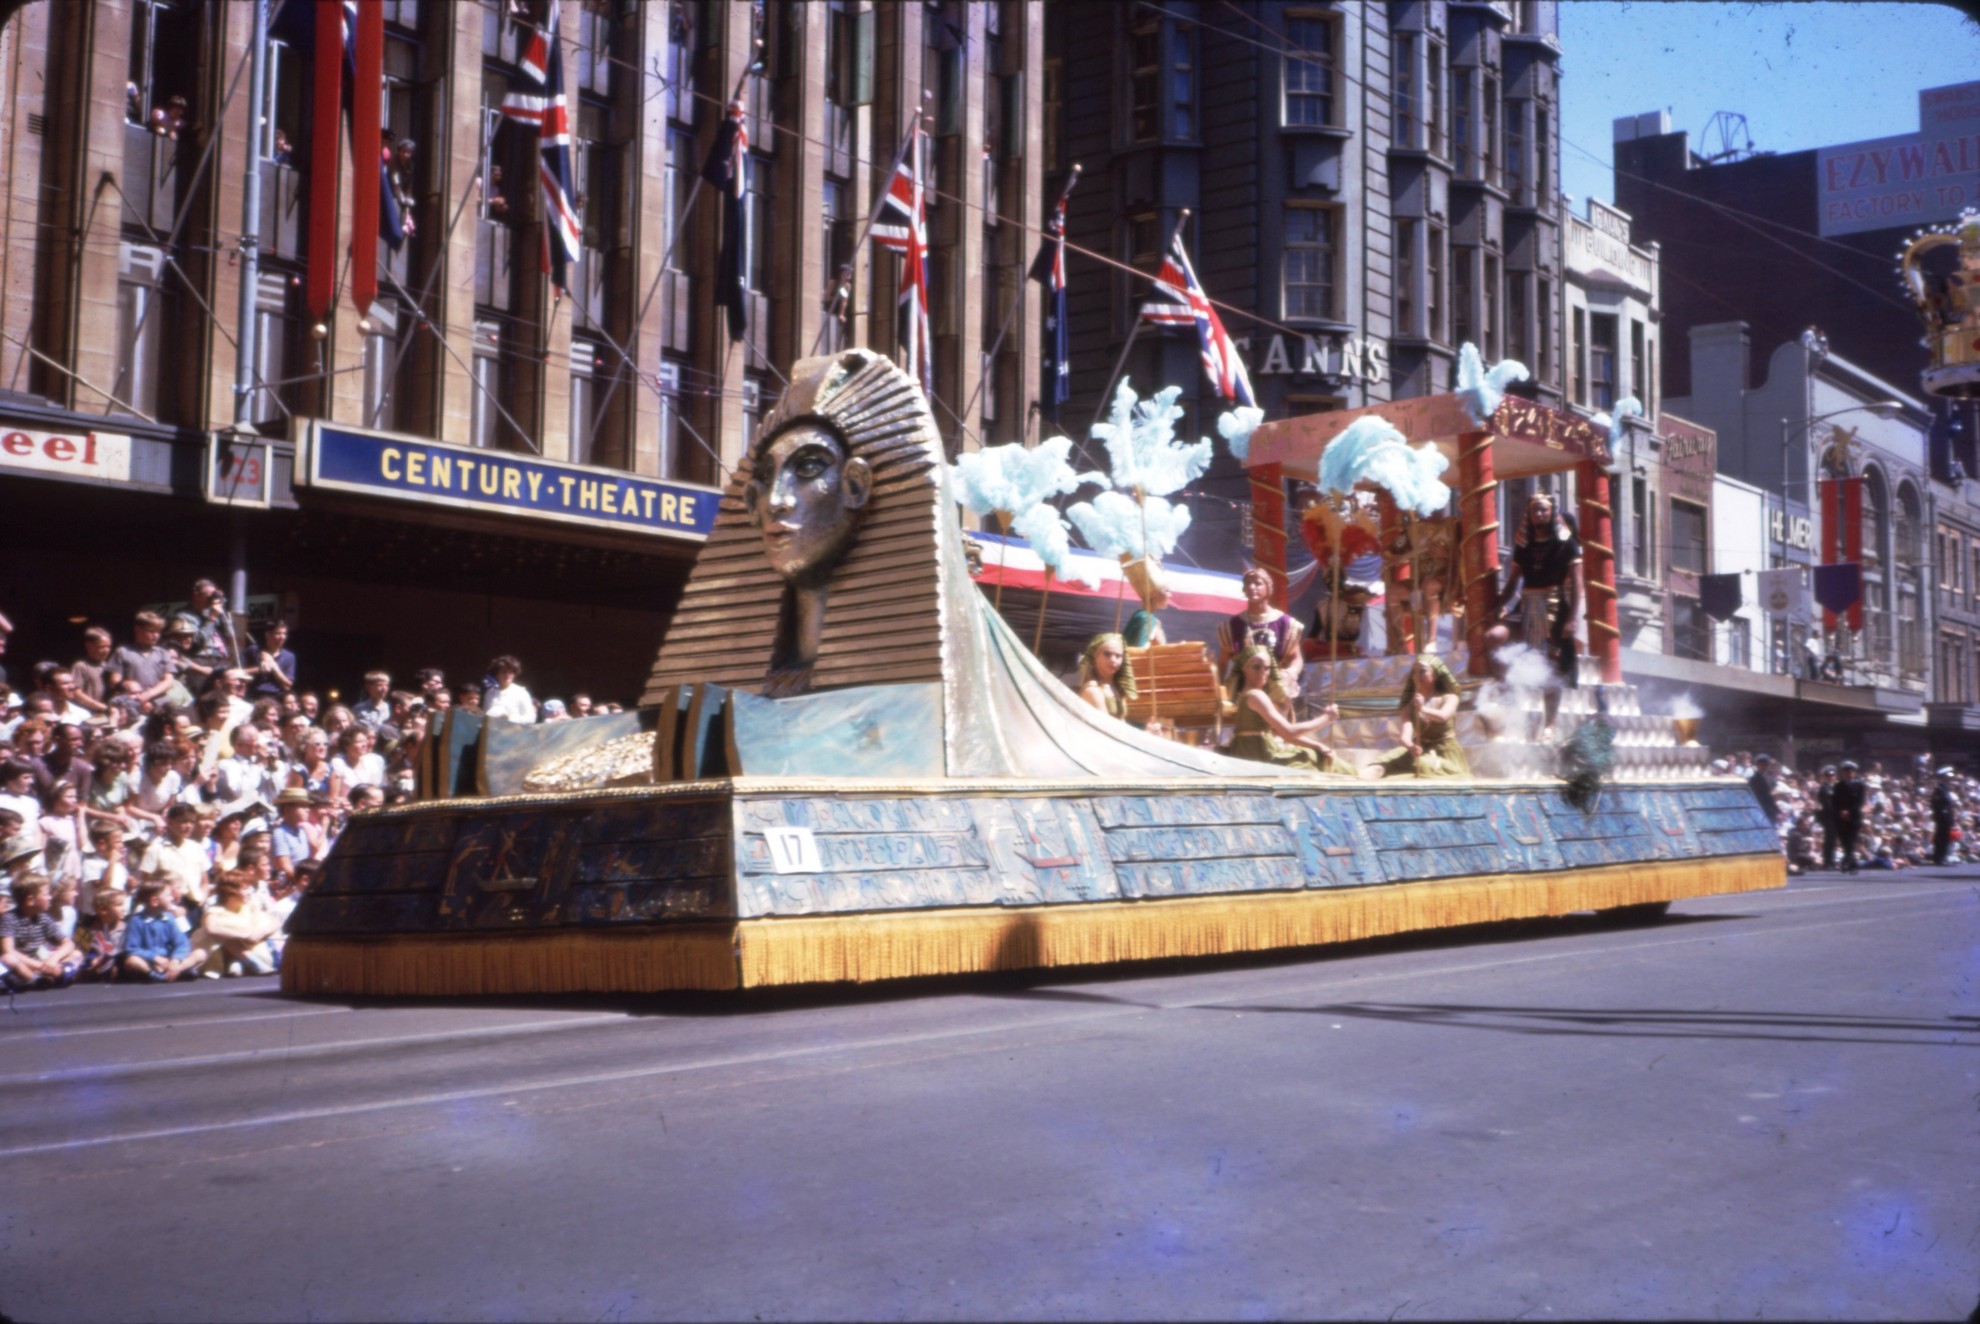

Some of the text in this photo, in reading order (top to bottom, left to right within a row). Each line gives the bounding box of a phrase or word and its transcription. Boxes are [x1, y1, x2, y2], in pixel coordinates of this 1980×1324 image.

[1826, 135, 1980, 192] EZYWAL
[1827, 191, 1925, 224] FACTORY
[1936, 184, 1965, 208] TO
[1585, 231, 1636, 277] BUILDING
[2, 431, 98, 465] eel
[381, 447, 697, 526] CENTURY THEATRE
[779, 833, 803, 867] 17
